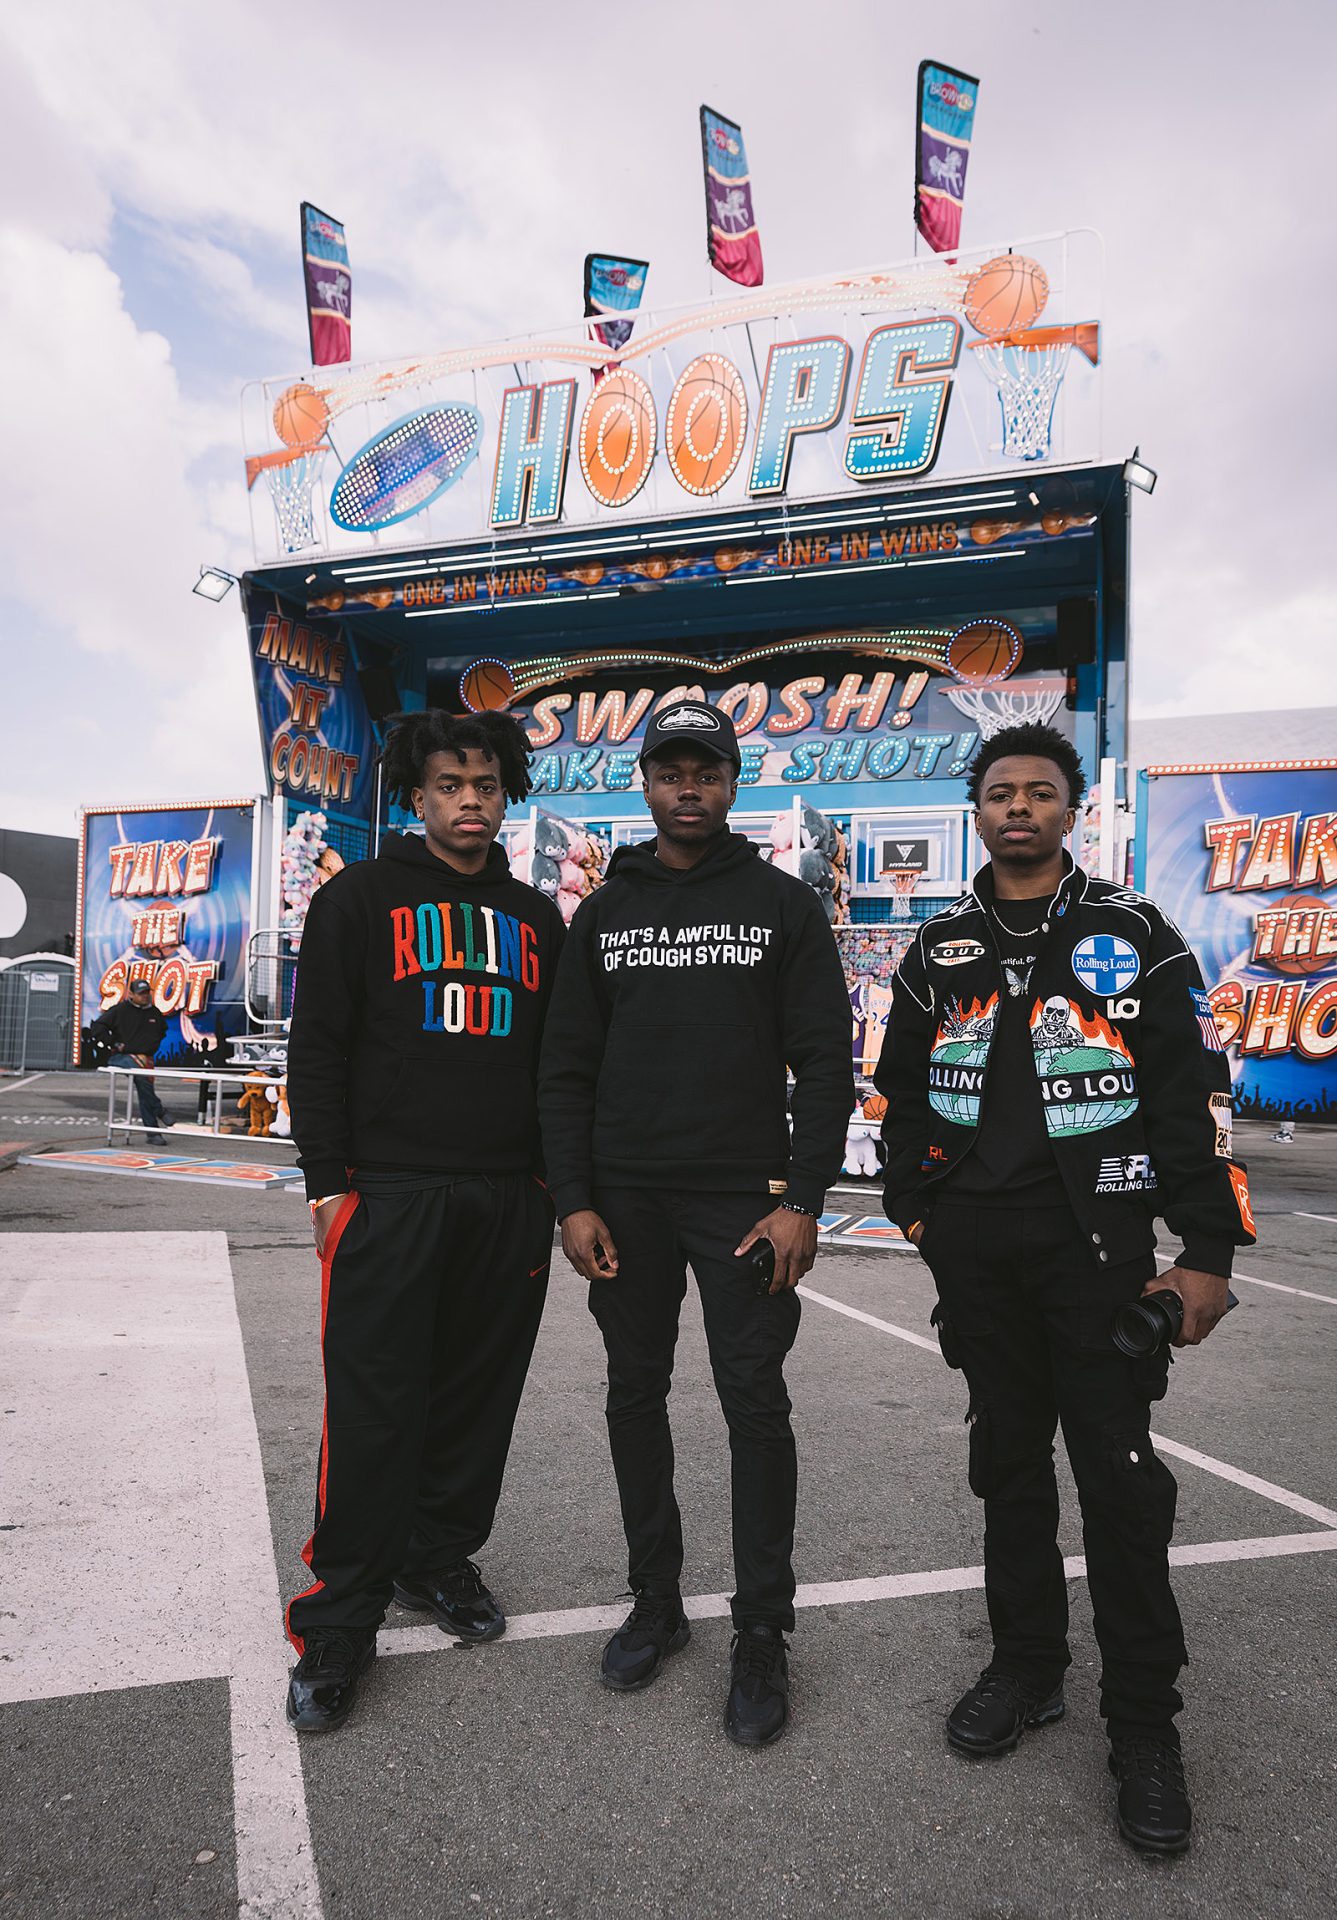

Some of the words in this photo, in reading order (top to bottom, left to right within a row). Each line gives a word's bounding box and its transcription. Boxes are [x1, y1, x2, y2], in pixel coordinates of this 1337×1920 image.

[488, 315, 962, 528] HOOPS
[777, 535, 831, 568] ONE
[841, 531, 870, 561] IN
[879, 521, 959, 557] WINS
[403, 577, 446, 607] ONE
[453, 574, 477, 602] IN
[485, 567, 548, 597] WINS
[256, 612, 345, 687] MAKE
[290, 681, 328, 731] IT
[270, 731, 360, 803] COUNT
[529, 748, 641, 793] AKE
[781, 732, 979, 782] SHOT!
[109, 837, 216, 899] TAKE
[131, 909, 183, 948] THE
[390, 902, 540, 992] ROLLING
[599, 926, 654, 950] THAT'S
[658, 926, 670, 944] A
[674, 924, 735, 945] AWFUL
[739, 924, 772, 946] LOT
[604, 950, 623, 972] OF
[626, 947, 692, 968] COUGH
[695, 944, 763, 967] SYRUP
[930, 947, 986, 958] LOUD
[1075, 957, 1109, 972] Rolling
[1109, 958, 1137, 969] Loud
[422, 981, 513, 1037] LOUD
[929, 1145, 949, 1160] RL
[1095, 1180, 1143, 1194] ROLLING
